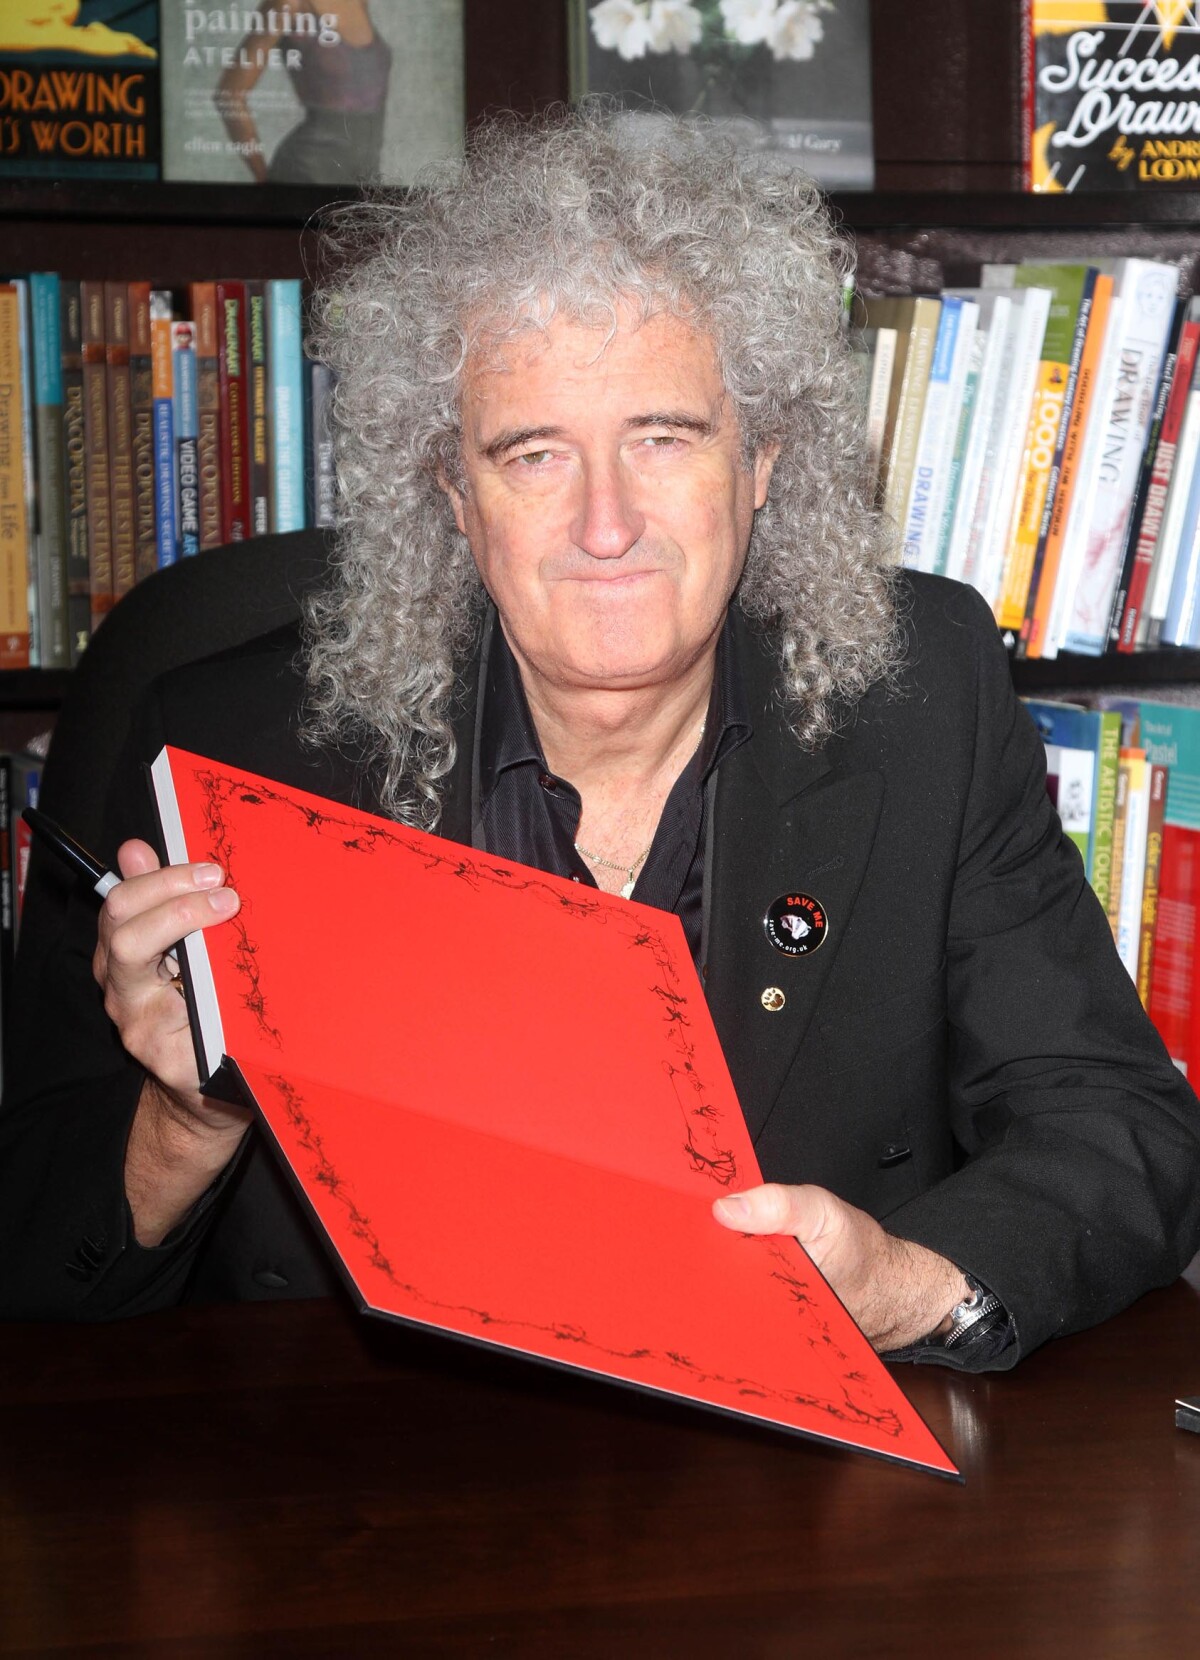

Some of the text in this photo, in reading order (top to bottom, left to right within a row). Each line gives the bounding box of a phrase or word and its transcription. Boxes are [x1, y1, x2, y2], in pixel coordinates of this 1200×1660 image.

[185, 4, 341, 47] painting
[183, 47, 302, 69] ATELIER
[1039, 31, 1200, 93] Succes
[31, 121, 145, 157] WORTH
[1051, 87, 1200, 148] Draw
[1107, 135, 1136, 172] by
[1078, 313, 1089, 326] Art
[1081, 297, 1091, 312] The
[1068, 337, 1084, 372] Drawing
[1062, 372, 1078, 404] Fantasy
[159, 404, 171, 458] REALISTIC
[1030, 388, 1064, 469] 1000
[1055, 404, 1072, 451] Characters
[1099, 347, 1142, 484] DRAWING
[62, 386, 87, 513] DRACOPEDIA
[179, 440, 194, 486] VIDEO
[132, 412, 156, 539] DRACOPEDIA
[160, 462, 172, 515] DRAWING
[198, 414, 221, 542] DRACOPEDIA
[0, 501, 16, 540] Life
[181, 487, 196, 531] GAME
[904, 466, 933, 557] DRAWING
[1135, 439, 1176, 563] JUST DRAW IT!
[93, 495, 111, 583] BESTIARY
[115, 497, 134, 585] BESTIARY
[1101, 726, 1119, 758] THE
[1096, 764, 1116, 836] ARTISTIC
[1146, 831, 1162, 865] Color
[786, 897, 823, 928] SAVE ME
[769, 919, 808, 954] save-me.org.uk
